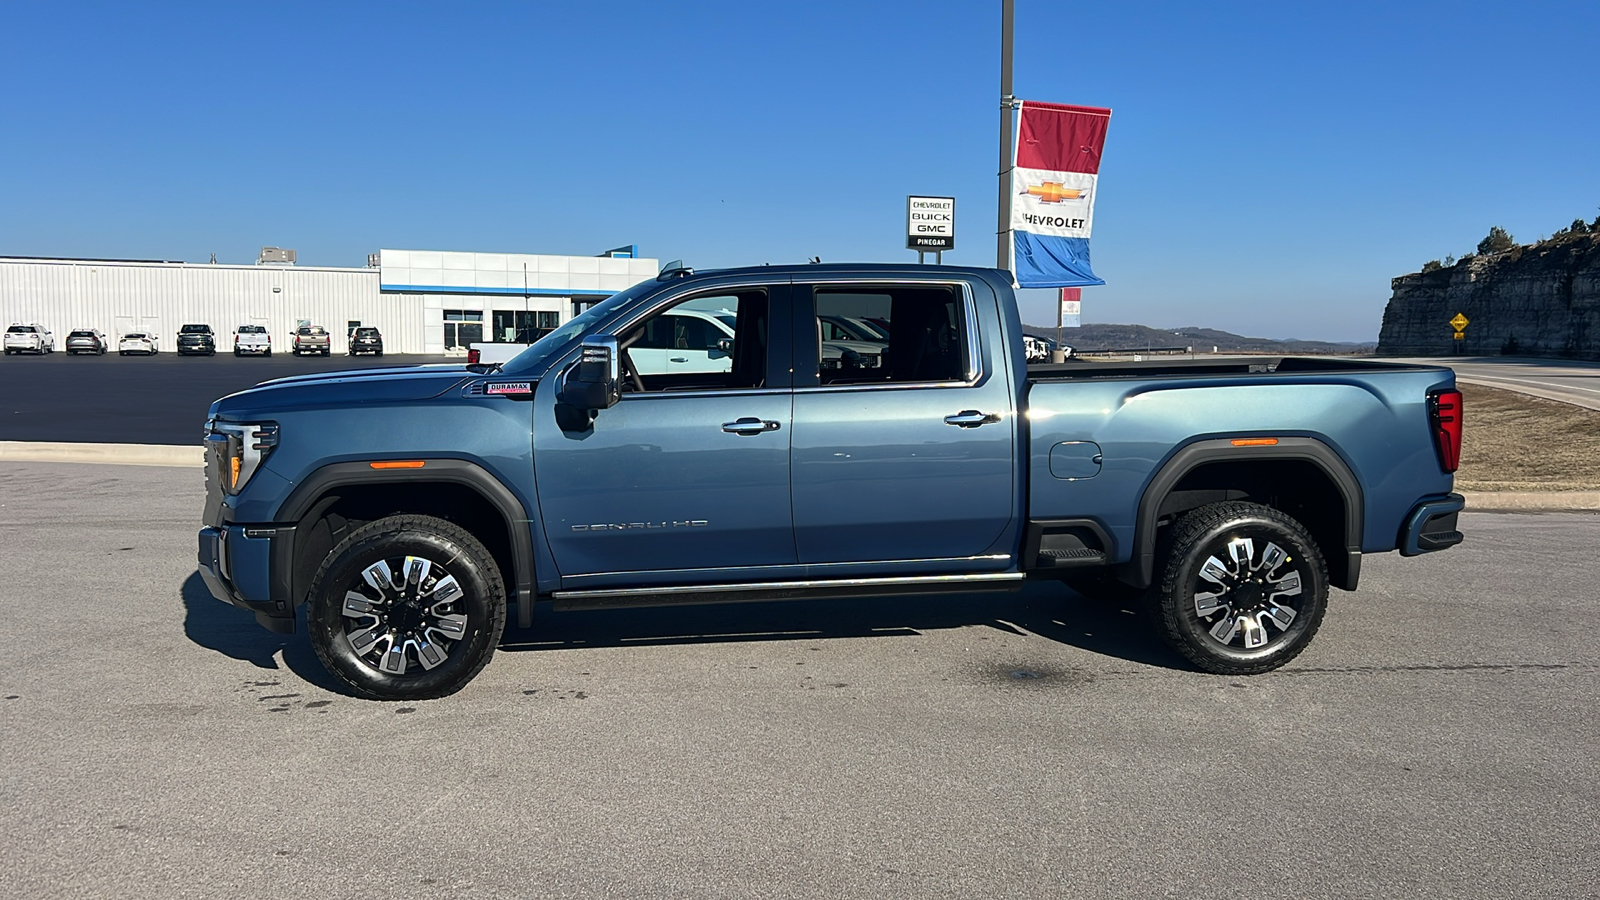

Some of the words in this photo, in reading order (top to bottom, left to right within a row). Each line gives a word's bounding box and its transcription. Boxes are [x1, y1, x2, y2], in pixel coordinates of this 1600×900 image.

[913, 201, 951, 209] CHEVROLET
[912, 213, 951, 221] BUICK
[917, 224, 946, 233] GMC
[571, 521, 667, 531] DENALI
